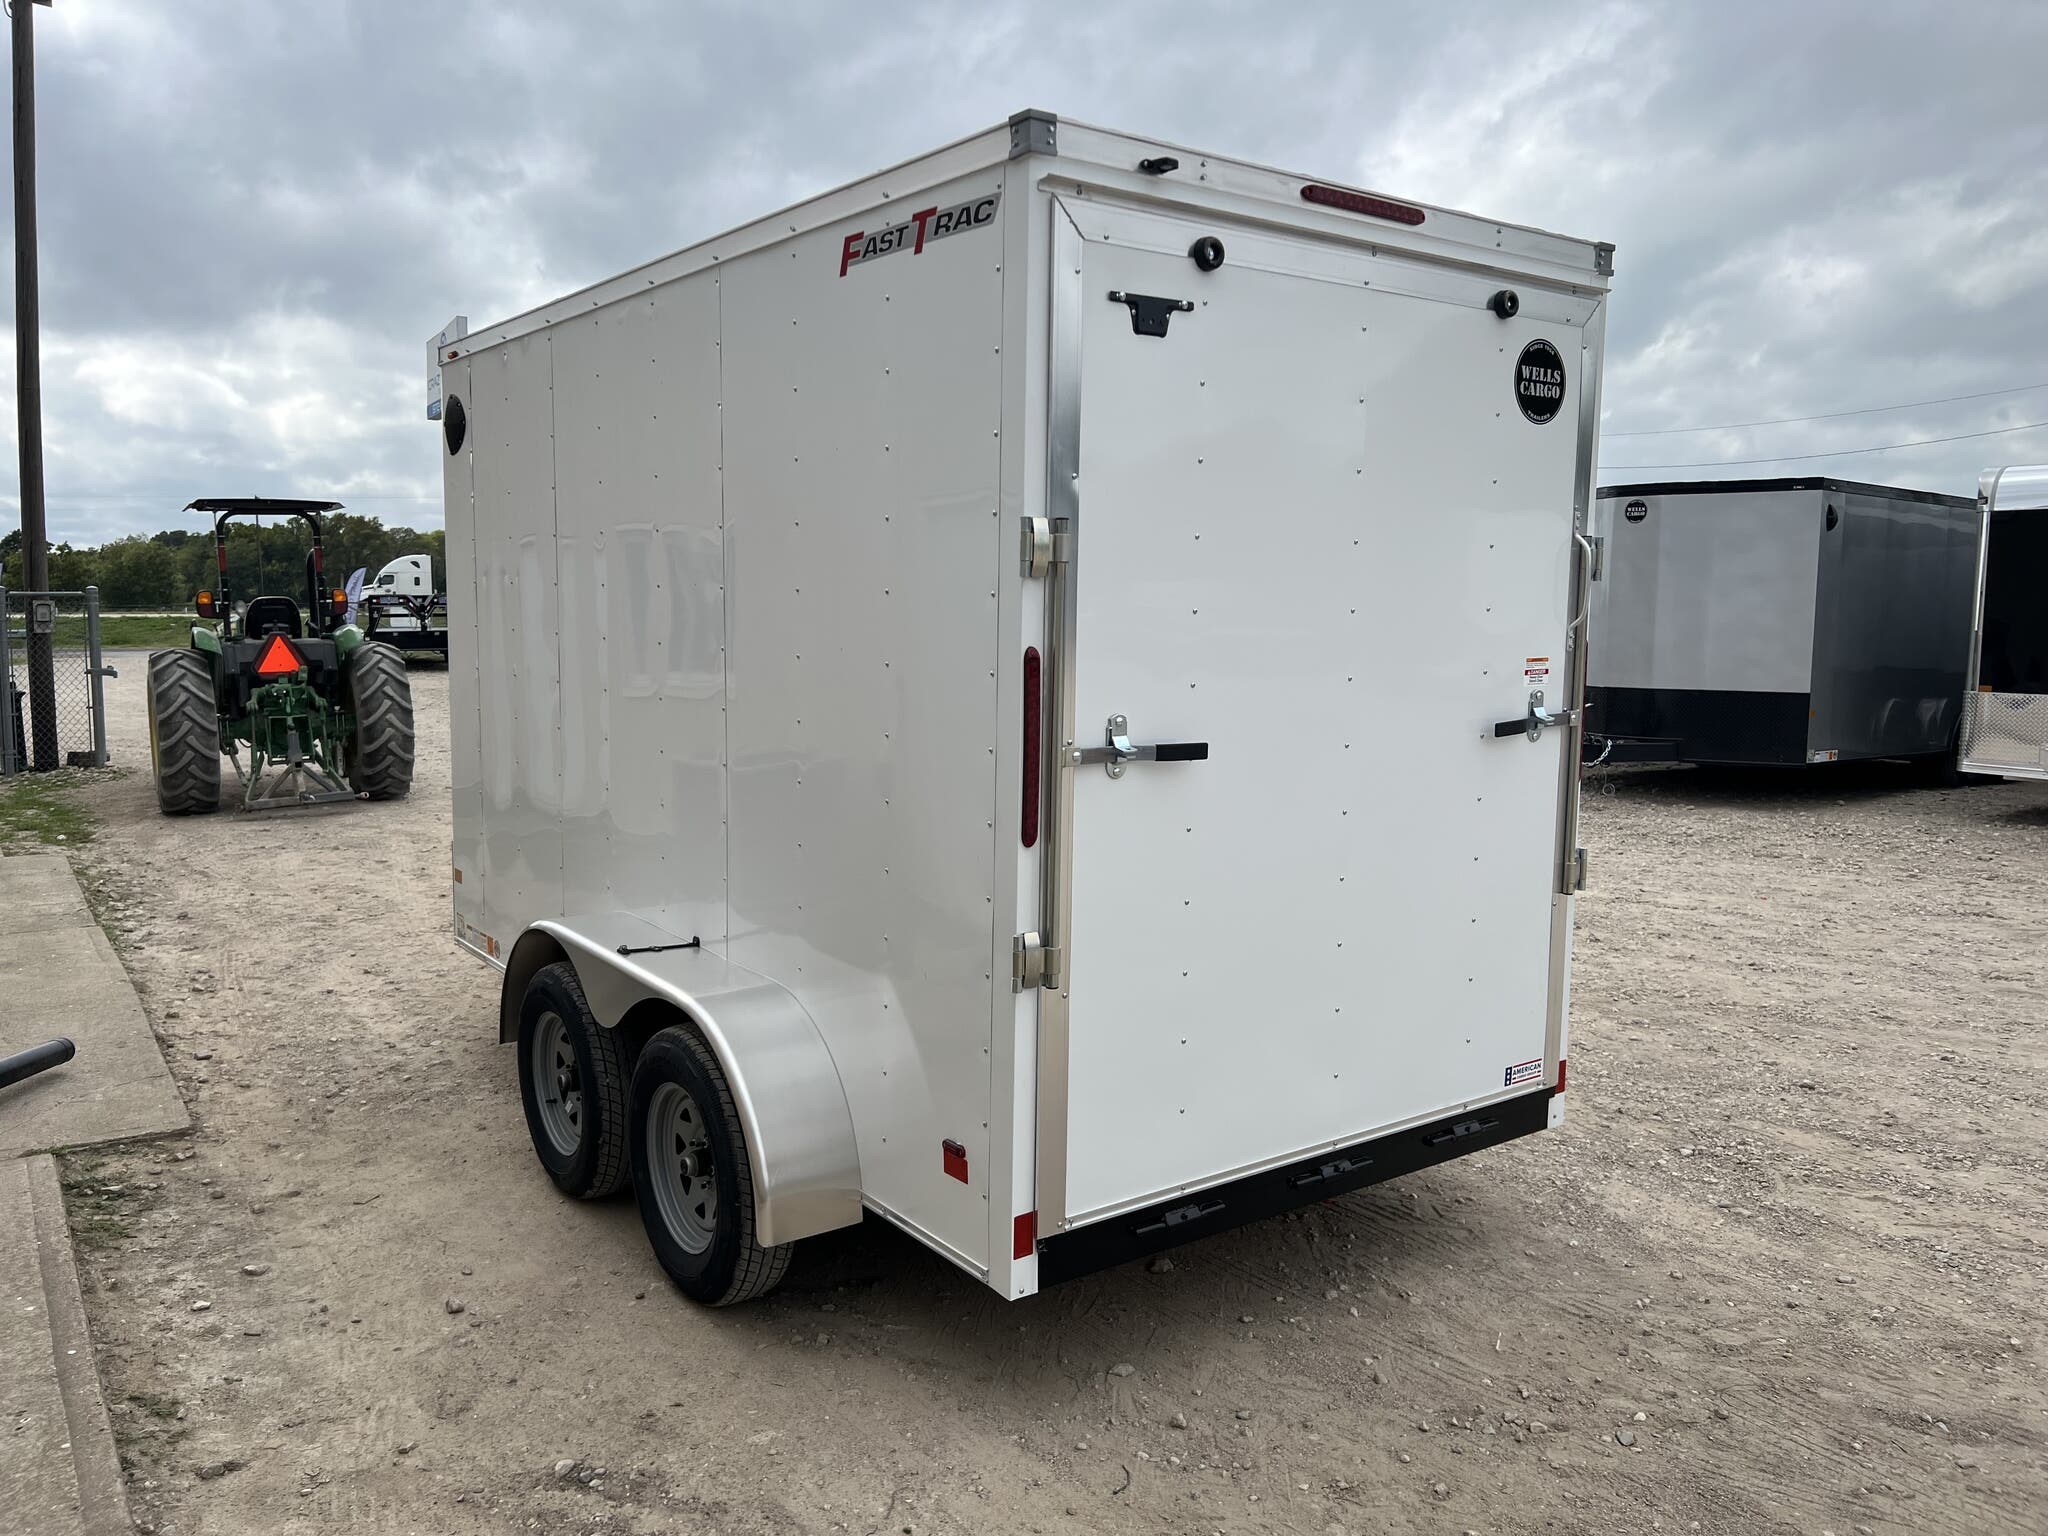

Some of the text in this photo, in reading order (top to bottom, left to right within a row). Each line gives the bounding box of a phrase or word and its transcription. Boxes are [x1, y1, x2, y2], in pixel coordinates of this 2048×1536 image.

[840, 200, 994, 277] FAST TRAC
[1521, 365, 1561, 383] WELLS
[1520, 381, 1560, 398] CARGO
[1512, 1062, 1542, 1076] AMERICAN
